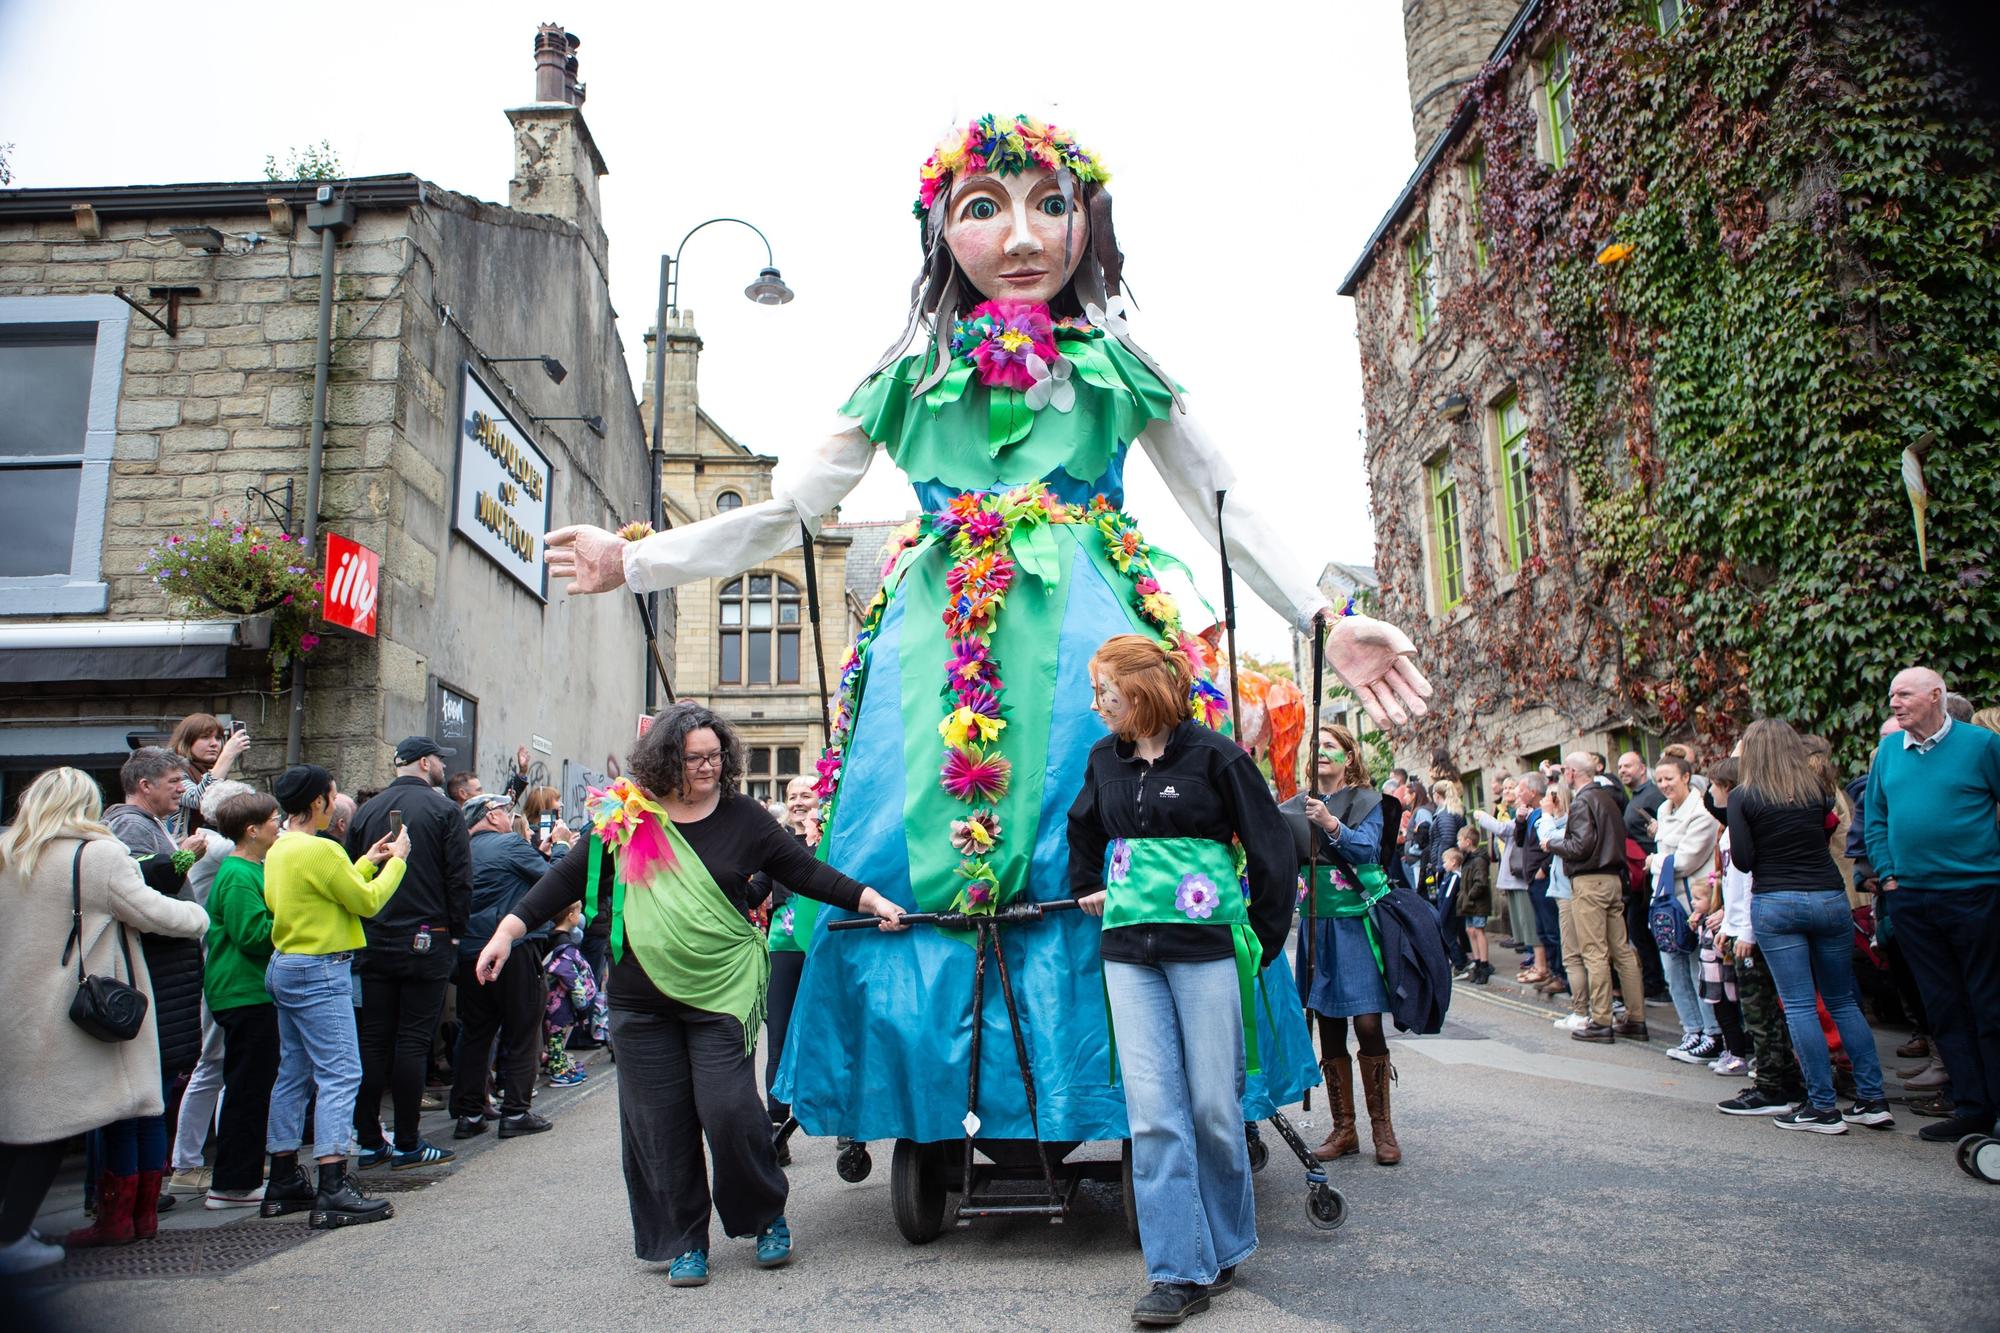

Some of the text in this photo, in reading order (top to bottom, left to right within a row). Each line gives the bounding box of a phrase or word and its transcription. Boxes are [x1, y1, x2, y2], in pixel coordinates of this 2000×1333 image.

[476, 408, 543, 501] SHOULDER
[479, 490, 535, 563] MUTTON
[330, 552, 376, 624] illy
